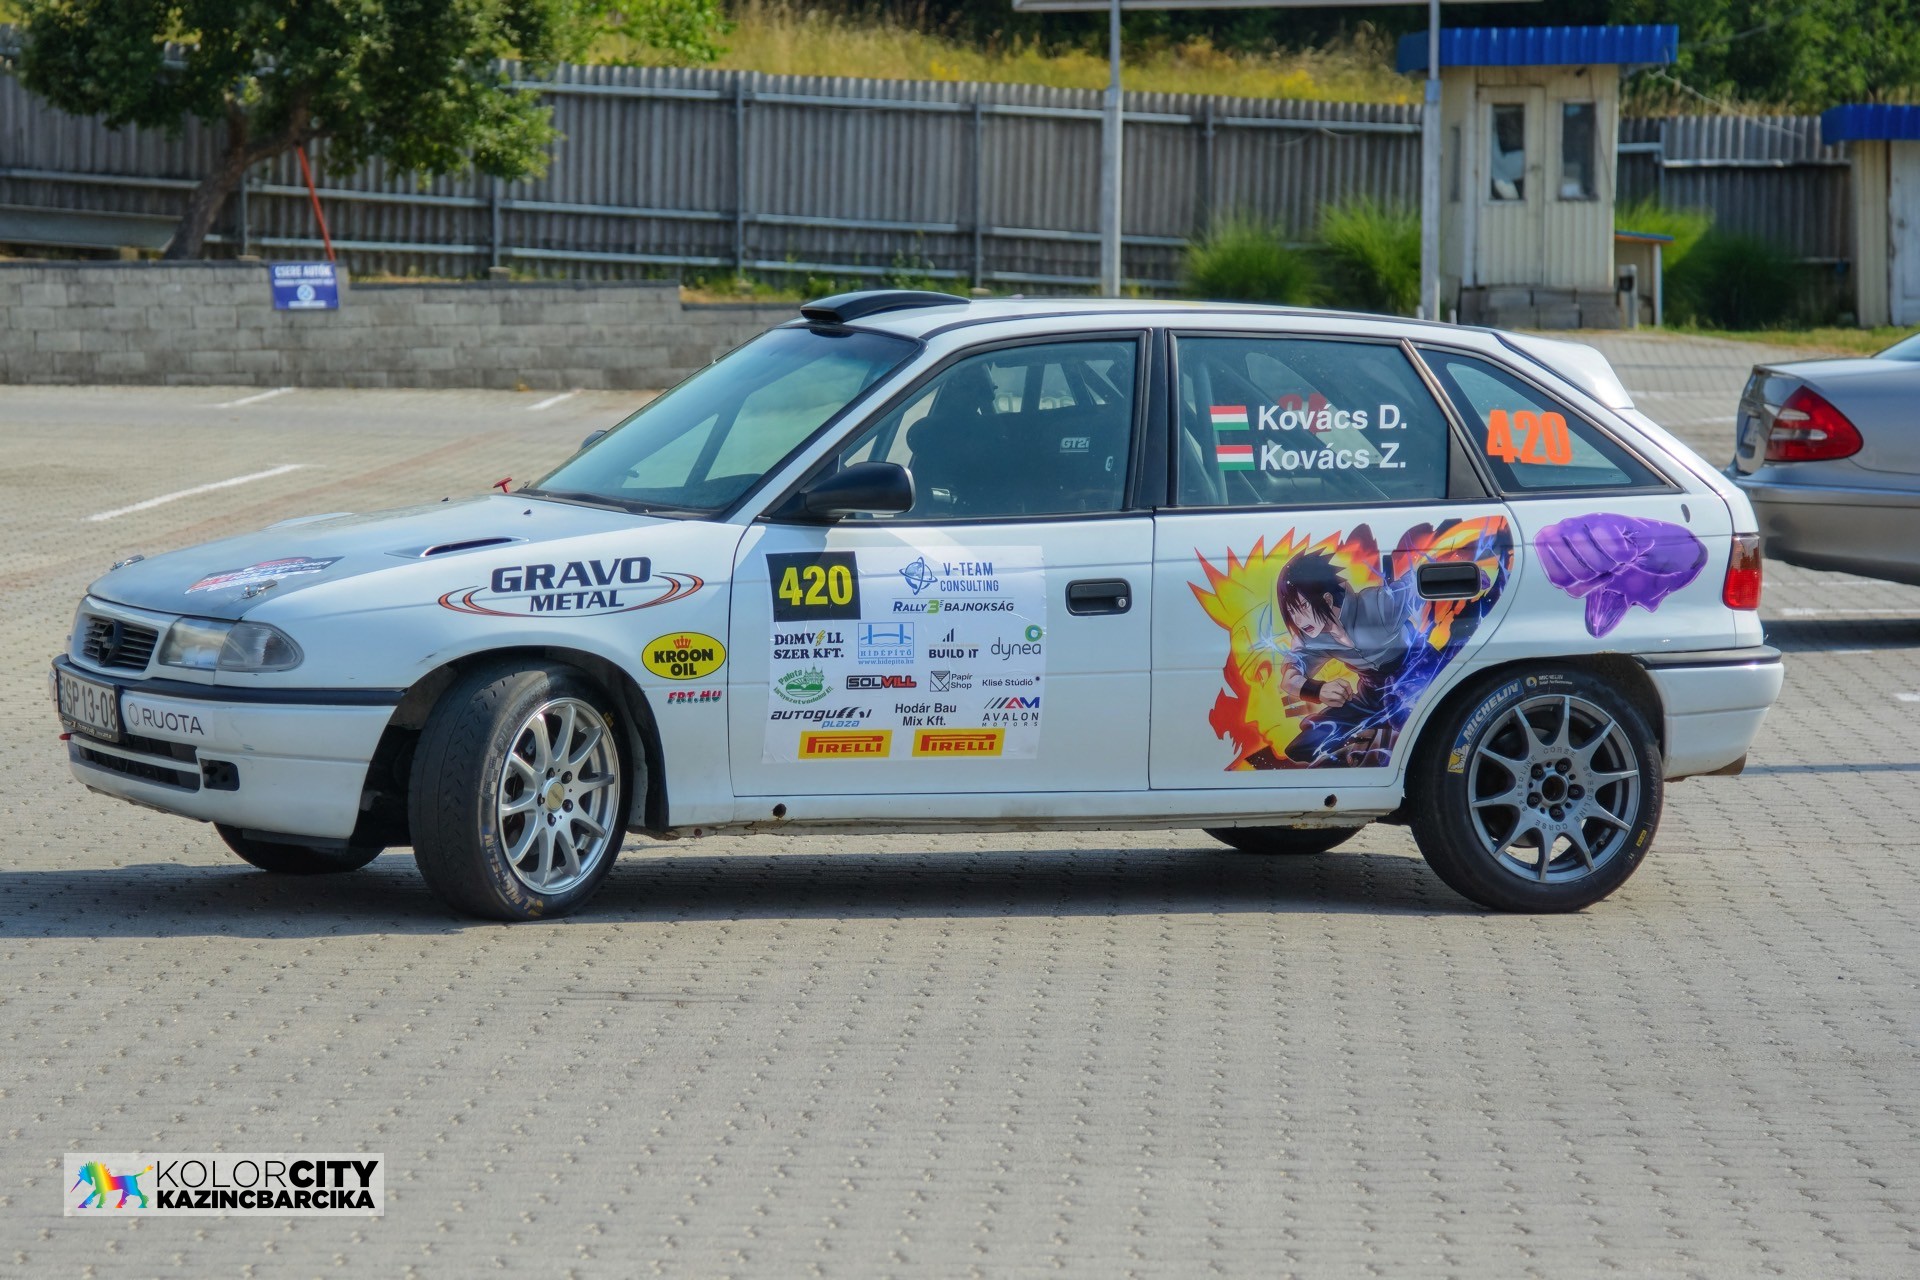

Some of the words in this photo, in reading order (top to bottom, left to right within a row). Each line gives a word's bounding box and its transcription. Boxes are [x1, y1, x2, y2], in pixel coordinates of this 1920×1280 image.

[1258, 404, 1368, 431] Kovács
[1379, 404, 1407, 430] D.
[1485, 409, 1573, 465] 420
[1260, 442, 1370, 471] Kovács
[1379, 442, 1406, 469] Z.
[491, 557, 652, 593] GRAVO
[943, 562, 994, 577] V-TEAM
[779, 565, 853, 606] 420
[940, 579, 999, 592] CONSULTING
[530, 590, 625, 612] METAL
[944, 600, 1014, 612] BAJNOKSÁG
[654, 648, 714, 663] KROON
[773, 648, 811, 660] SZER
[813, 647, 845, 659] KFT.
[928, 649, 965, 659] BUILD
[968, 649, 979, 659] IT
[990, 636, 1042, 661] dynea
[670, 662, 697, 676] OIL
[847, 675, 917, 690] SOLVILL
[951, 673, 973, 681] Papír
[982, 678, 1003, 687] Klisé
[1004, 677, 1033, 687] Stúdió
[951, 682, 972, 690] Shop
[667, 690, 723, 705] FRT.HU
[895, 702, 931, 713] Hodár
[934, 703, 957, 713] Bau
[1463, 682, 1519, 741] MICHELIN
[142, 708, 205, 736] RUOTA
[902, 716, 923, 726] Mix
[926, 715, 946, 726] Kft.
[982, 712, 1039, 721] AVALON
[806, 735, 884, 754] PIRELLI
[920, 733, 997, 752] PIRELLI
